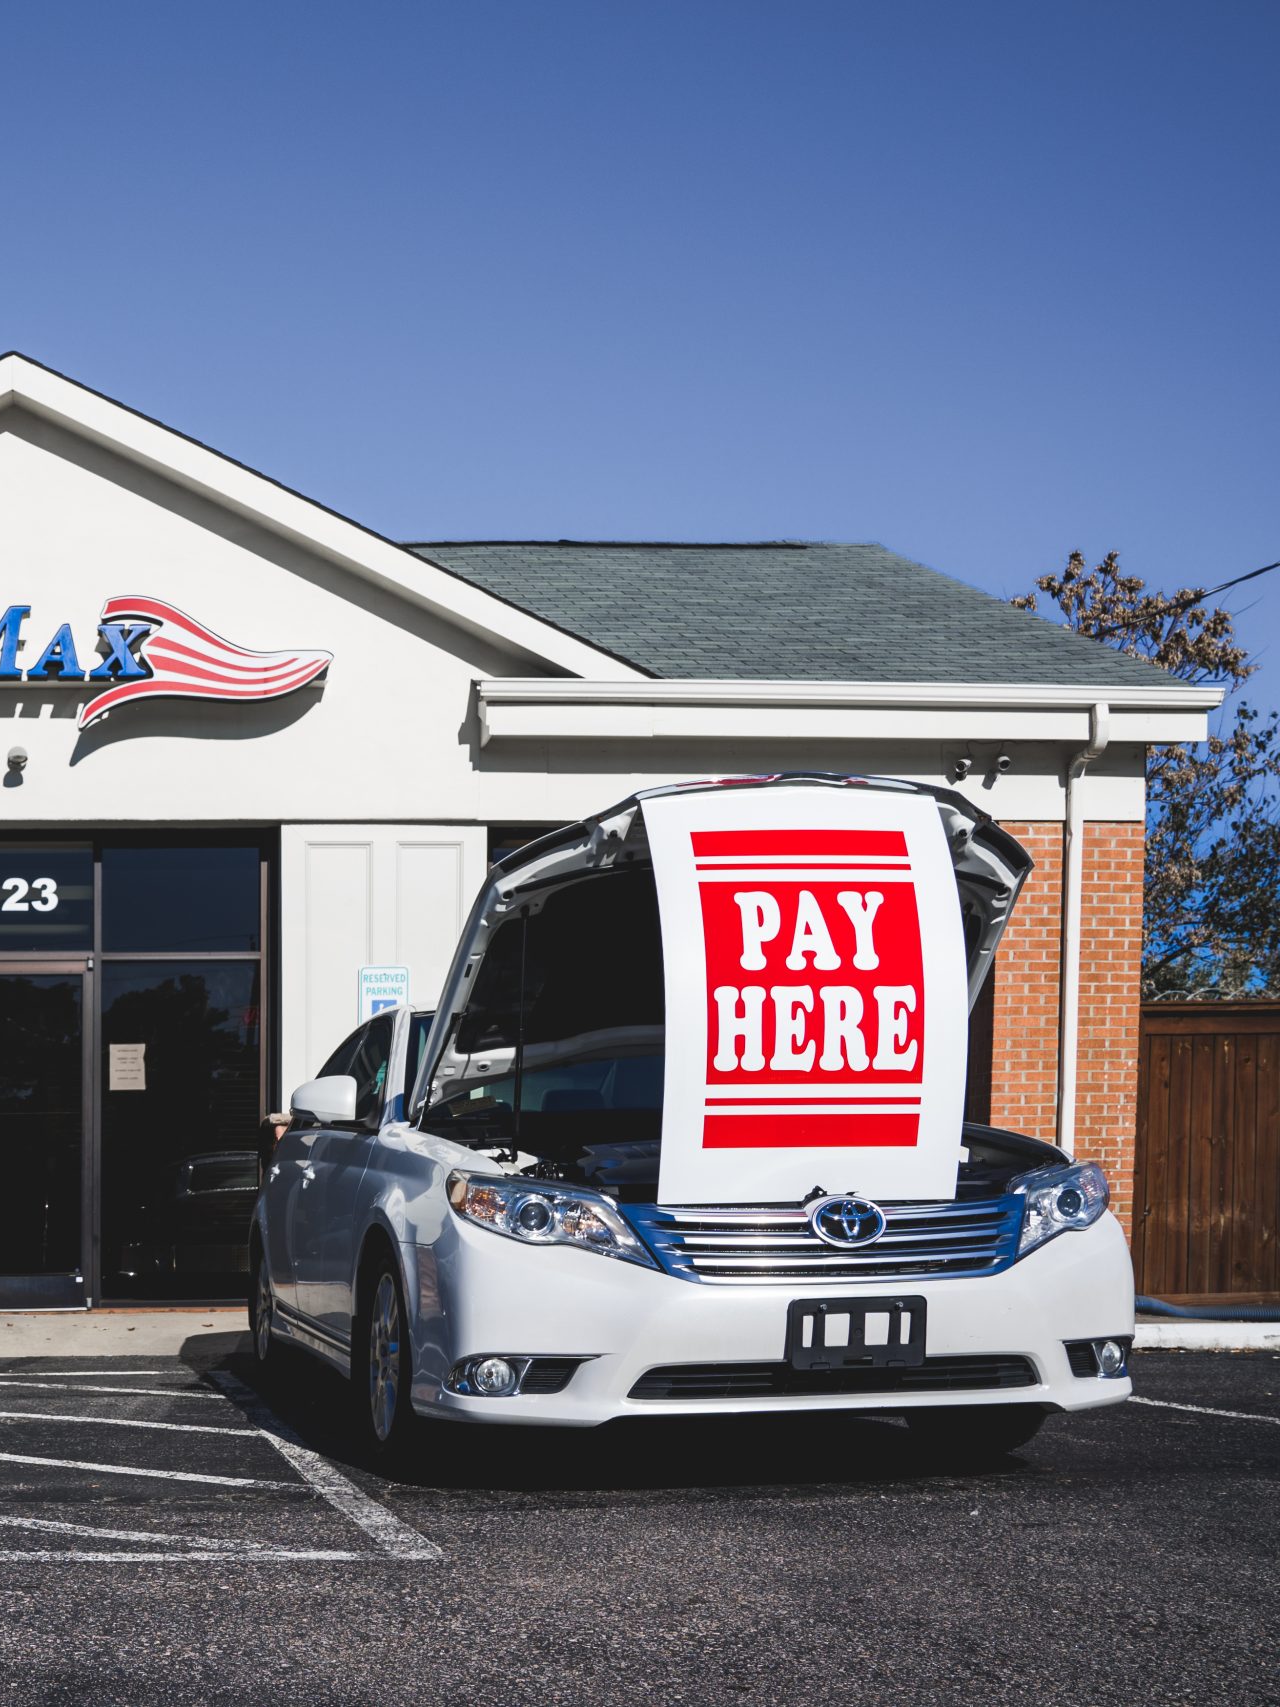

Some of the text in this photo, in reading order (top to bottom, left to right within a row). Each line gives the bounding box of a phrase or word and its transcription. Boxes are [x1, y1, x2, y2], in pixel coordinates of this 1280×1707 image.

[733, 890, 885, 971] PAY
[363, 974, 406, 983] RESERVED
[366, 987, 403, 996] PARKING
[713, 984, 918, 1073] HERE
